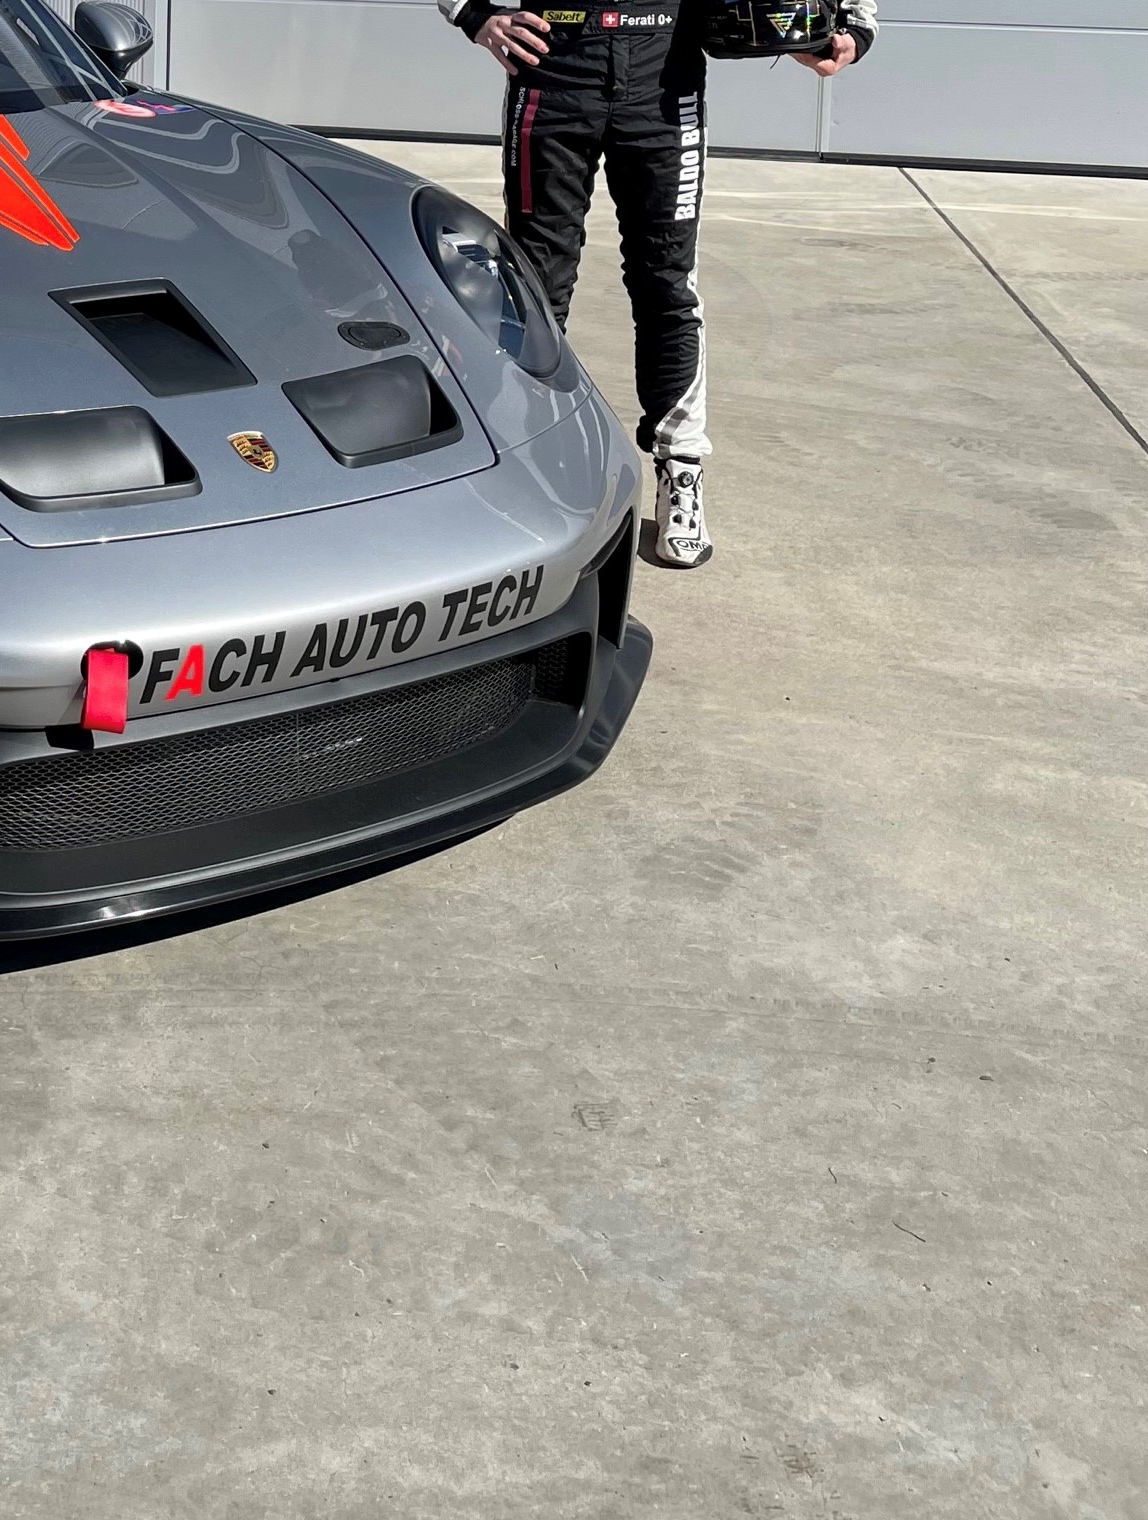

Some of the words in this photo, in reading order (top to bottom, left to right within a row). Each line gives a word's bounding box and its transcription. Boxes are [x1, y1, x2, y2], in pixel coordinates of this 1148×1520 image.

[546, 10, 581, 21] Sabelt
[620, 14, 655, 26] Ferati
[678, 91, 700, 147] BULL
[674, 149, 700, 221] BALDO
[139, 630, 286, 705] FACH
[291, 601, 427, 678] AUTO
[438, 564, 545, 642] TECH
